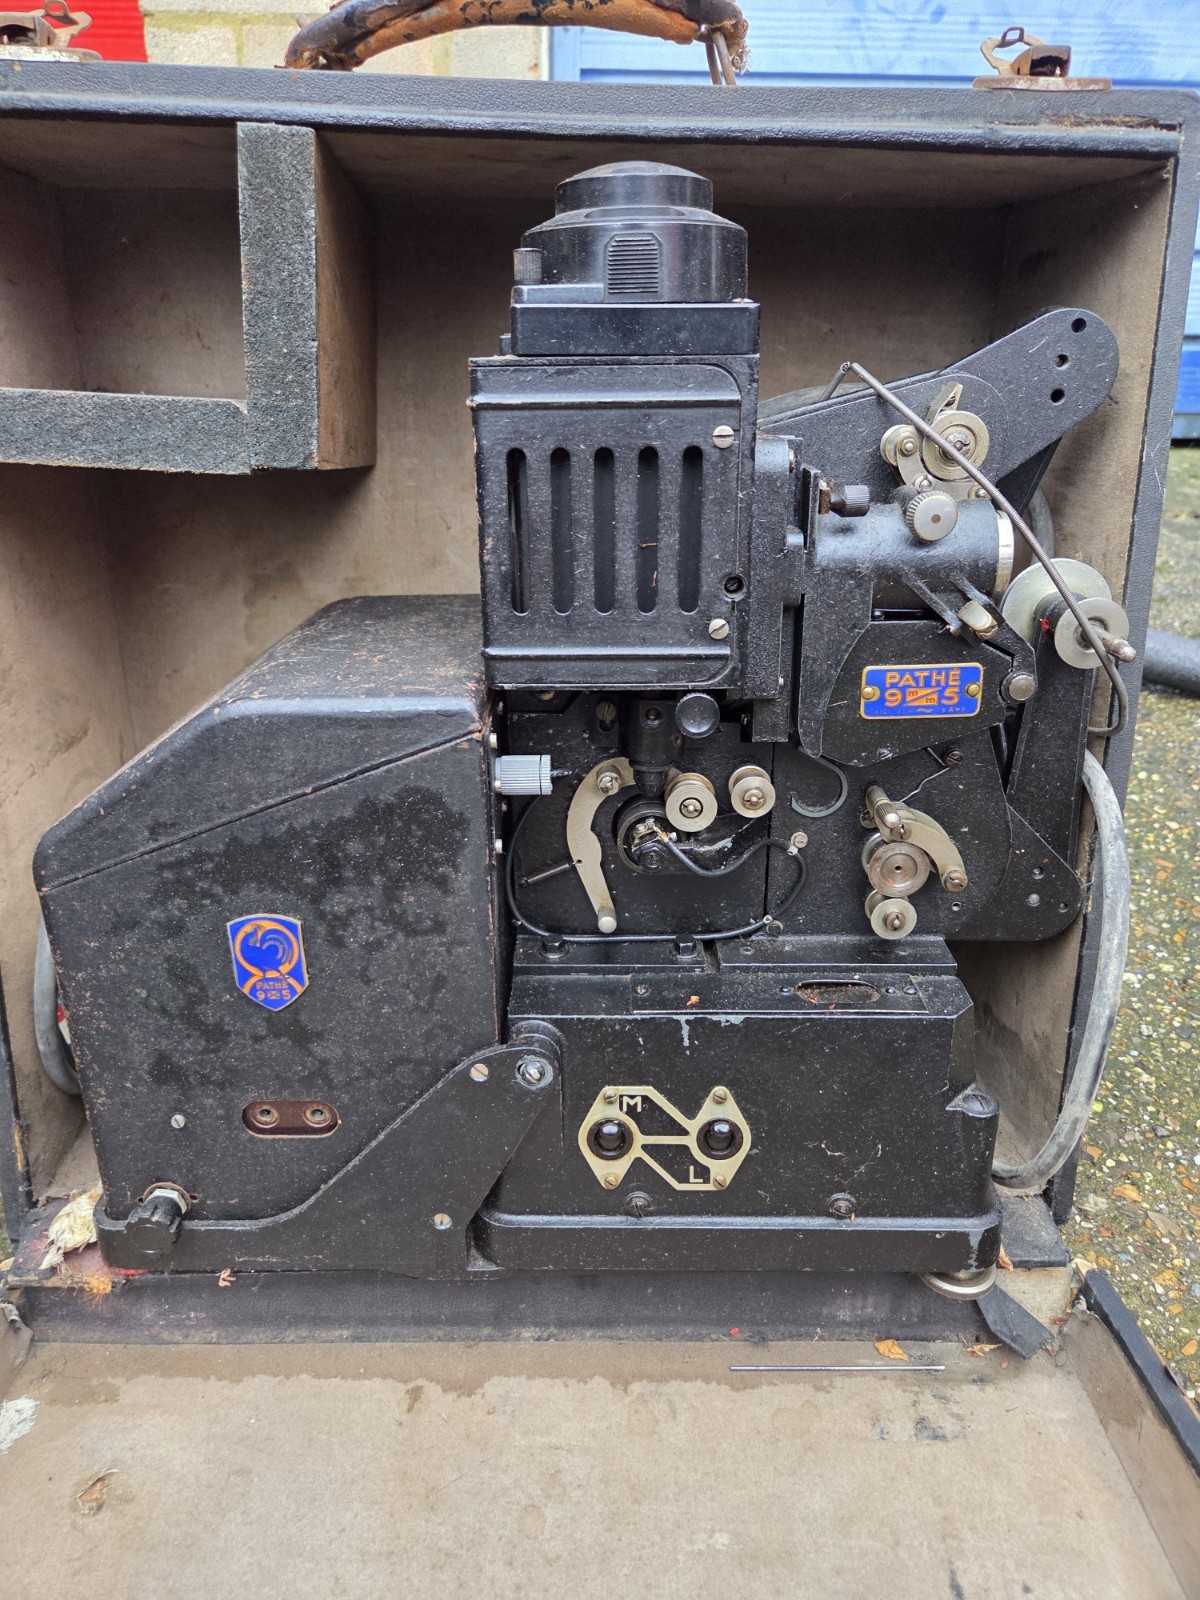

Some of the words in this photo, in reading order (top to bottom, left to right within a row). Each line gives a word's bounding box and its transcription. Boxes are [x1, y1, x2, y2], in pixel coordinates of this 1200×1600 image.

[884, 688, 903, 707] 9
[941, 687, 960, 705] 5
[256, 990, 266, 1001] 9
[281, 989, 291, 1000] 5
[622, 1095, 642, 1113] M
[689, 1165, 704, 1183] L
